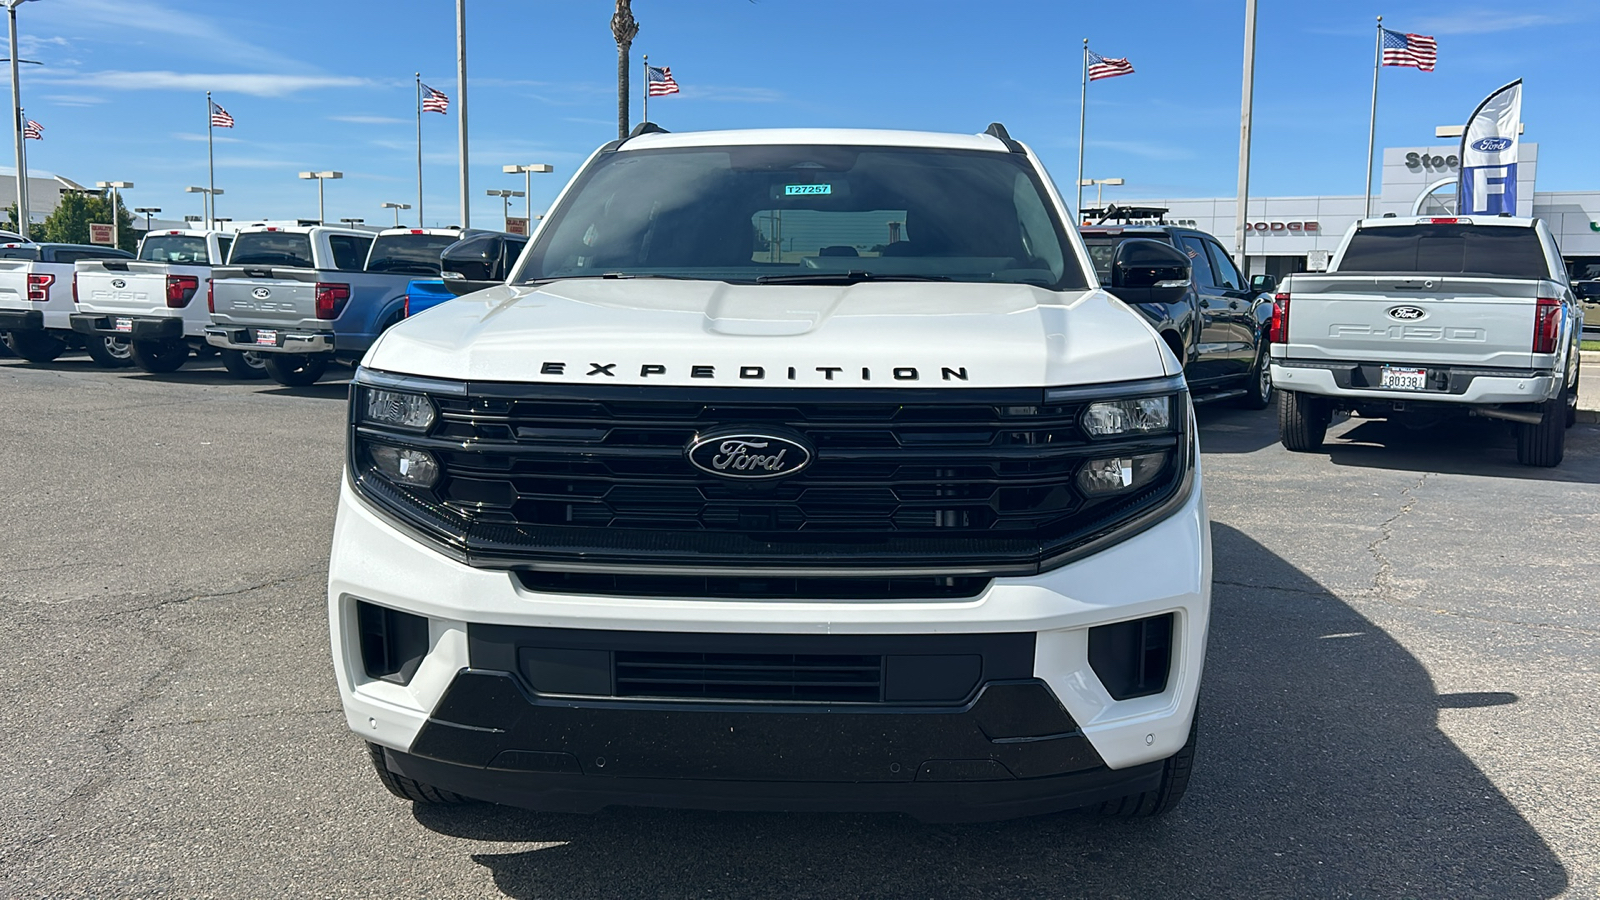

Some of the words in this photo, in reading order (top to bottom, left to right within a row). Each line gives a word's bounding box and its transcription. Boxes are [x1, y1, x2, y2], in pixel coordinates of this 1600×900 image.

[1479, 138, 1508, 151] Ford
[1405, 152, 1458, 169] Stoc
[787, 186, 828, 194] T27257
[1130, 219, 1197, 227] HRYSLER
[92, 290, 149, 302] F-150
[230, 300, 297, 312] F-150
[1395, 307, 1418, 319] Ford
[1329, 323, 1487, 342] F-150
[540, 361, 969, 381] EXPEDITION
[1388, 376, 1418, 388] 80338
[712, 440, 786, 471] Ford
